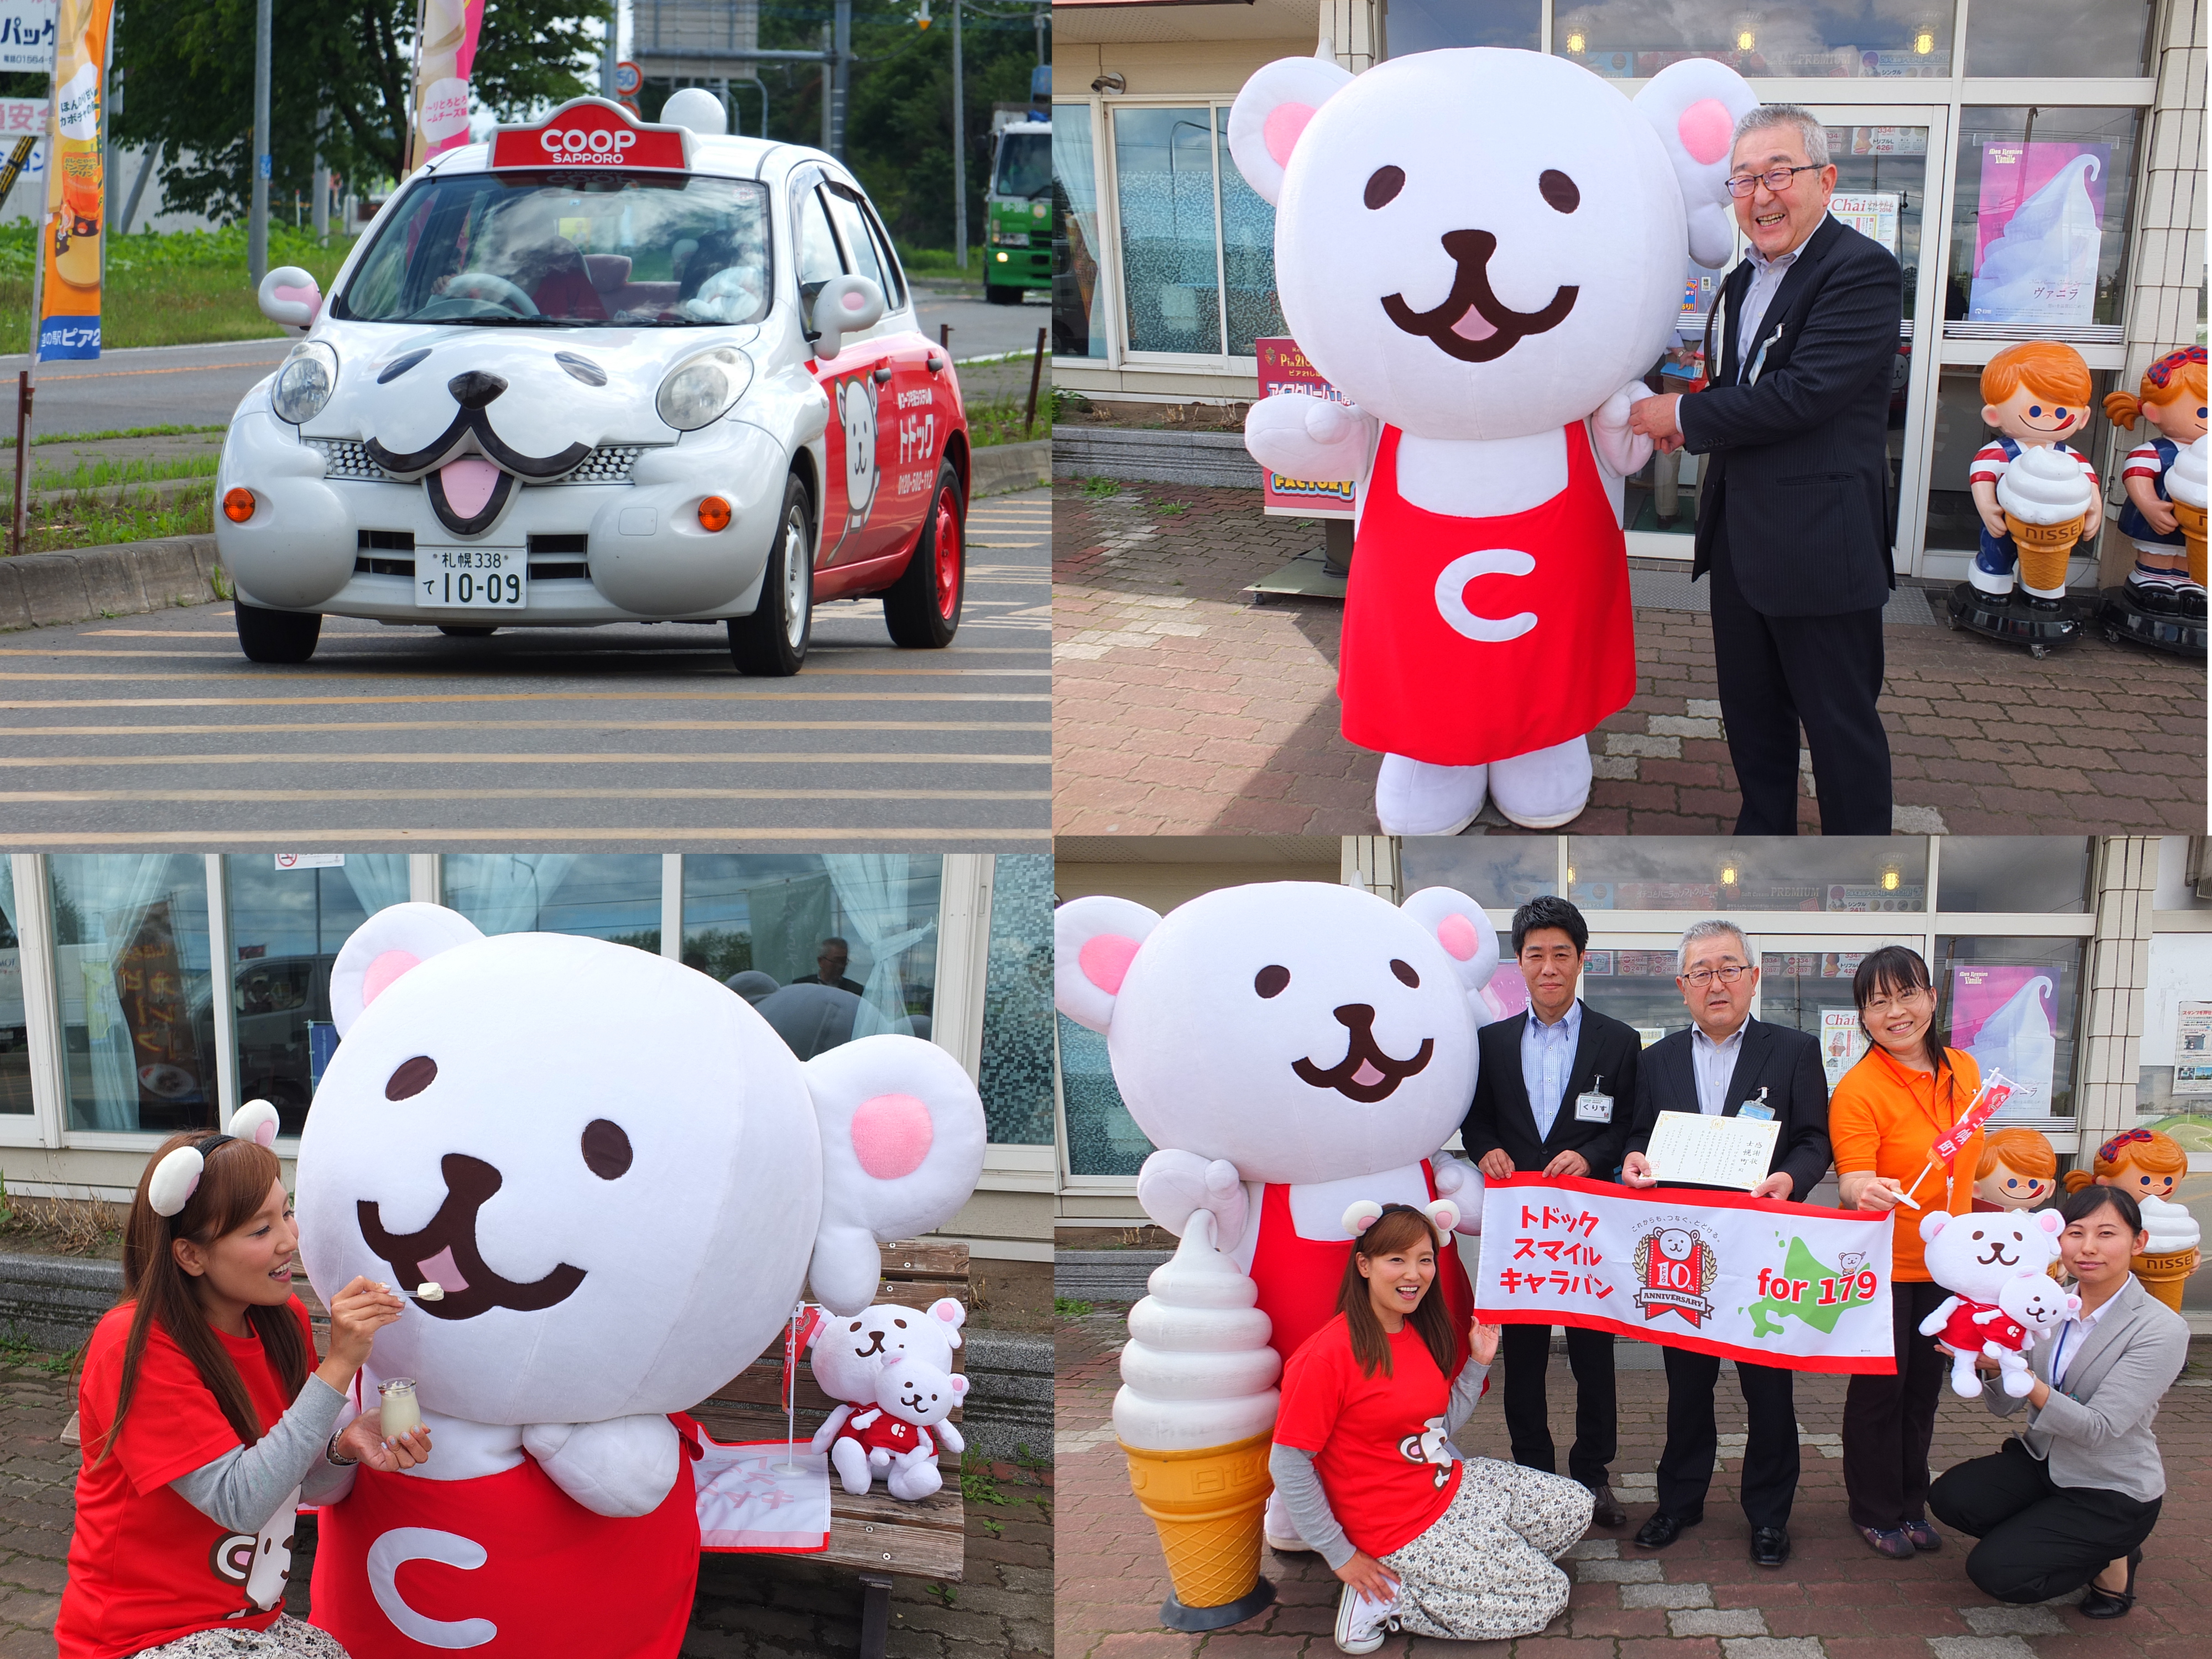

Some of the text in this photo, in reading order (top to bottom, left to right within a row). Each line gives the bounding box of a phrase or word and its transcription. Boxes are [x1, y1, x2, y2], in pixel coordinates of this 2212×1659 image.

[1798, 54, 1851, 65] PREMIUM
[540, 129, 637, 153] COOP
[552, 153, 624, 164] SAPPORO
[1995, 155, 2016, 164] Vanille
[1831, 198, 1866, 212] Chai
[2033, 286, 2078, 300] ヴァニラ
[899, 413, 934, 465] トドック
[898, 469, 933, 495] 0120-502-112
[1274, 473, 1353, 494] FACTORY
[422, 572, 520, 604] て 10-09
[1434, 549, 1538, 643] C
[1770, 887, 1820, 897] PREMIUM
[1964, 977, 1982, 985] Vanille
[1825, 1014, 1856, 1025] Chai
[1583, 1104, 1607, 1112] くりす
[1749, 1141, 1763, 1165] 感謝状
[1521, 1205, 1600, 1239] トドック
[1512, 1238, 1603, 1267] スマイル
[1499, 1267, 1614, 1300] キャラバン
[1757, 1267, 1877, 1305] for 179
[1643, 1292, 1704, 1308] ANNIVERSARY
[367, 1527, 497, 1648] C
